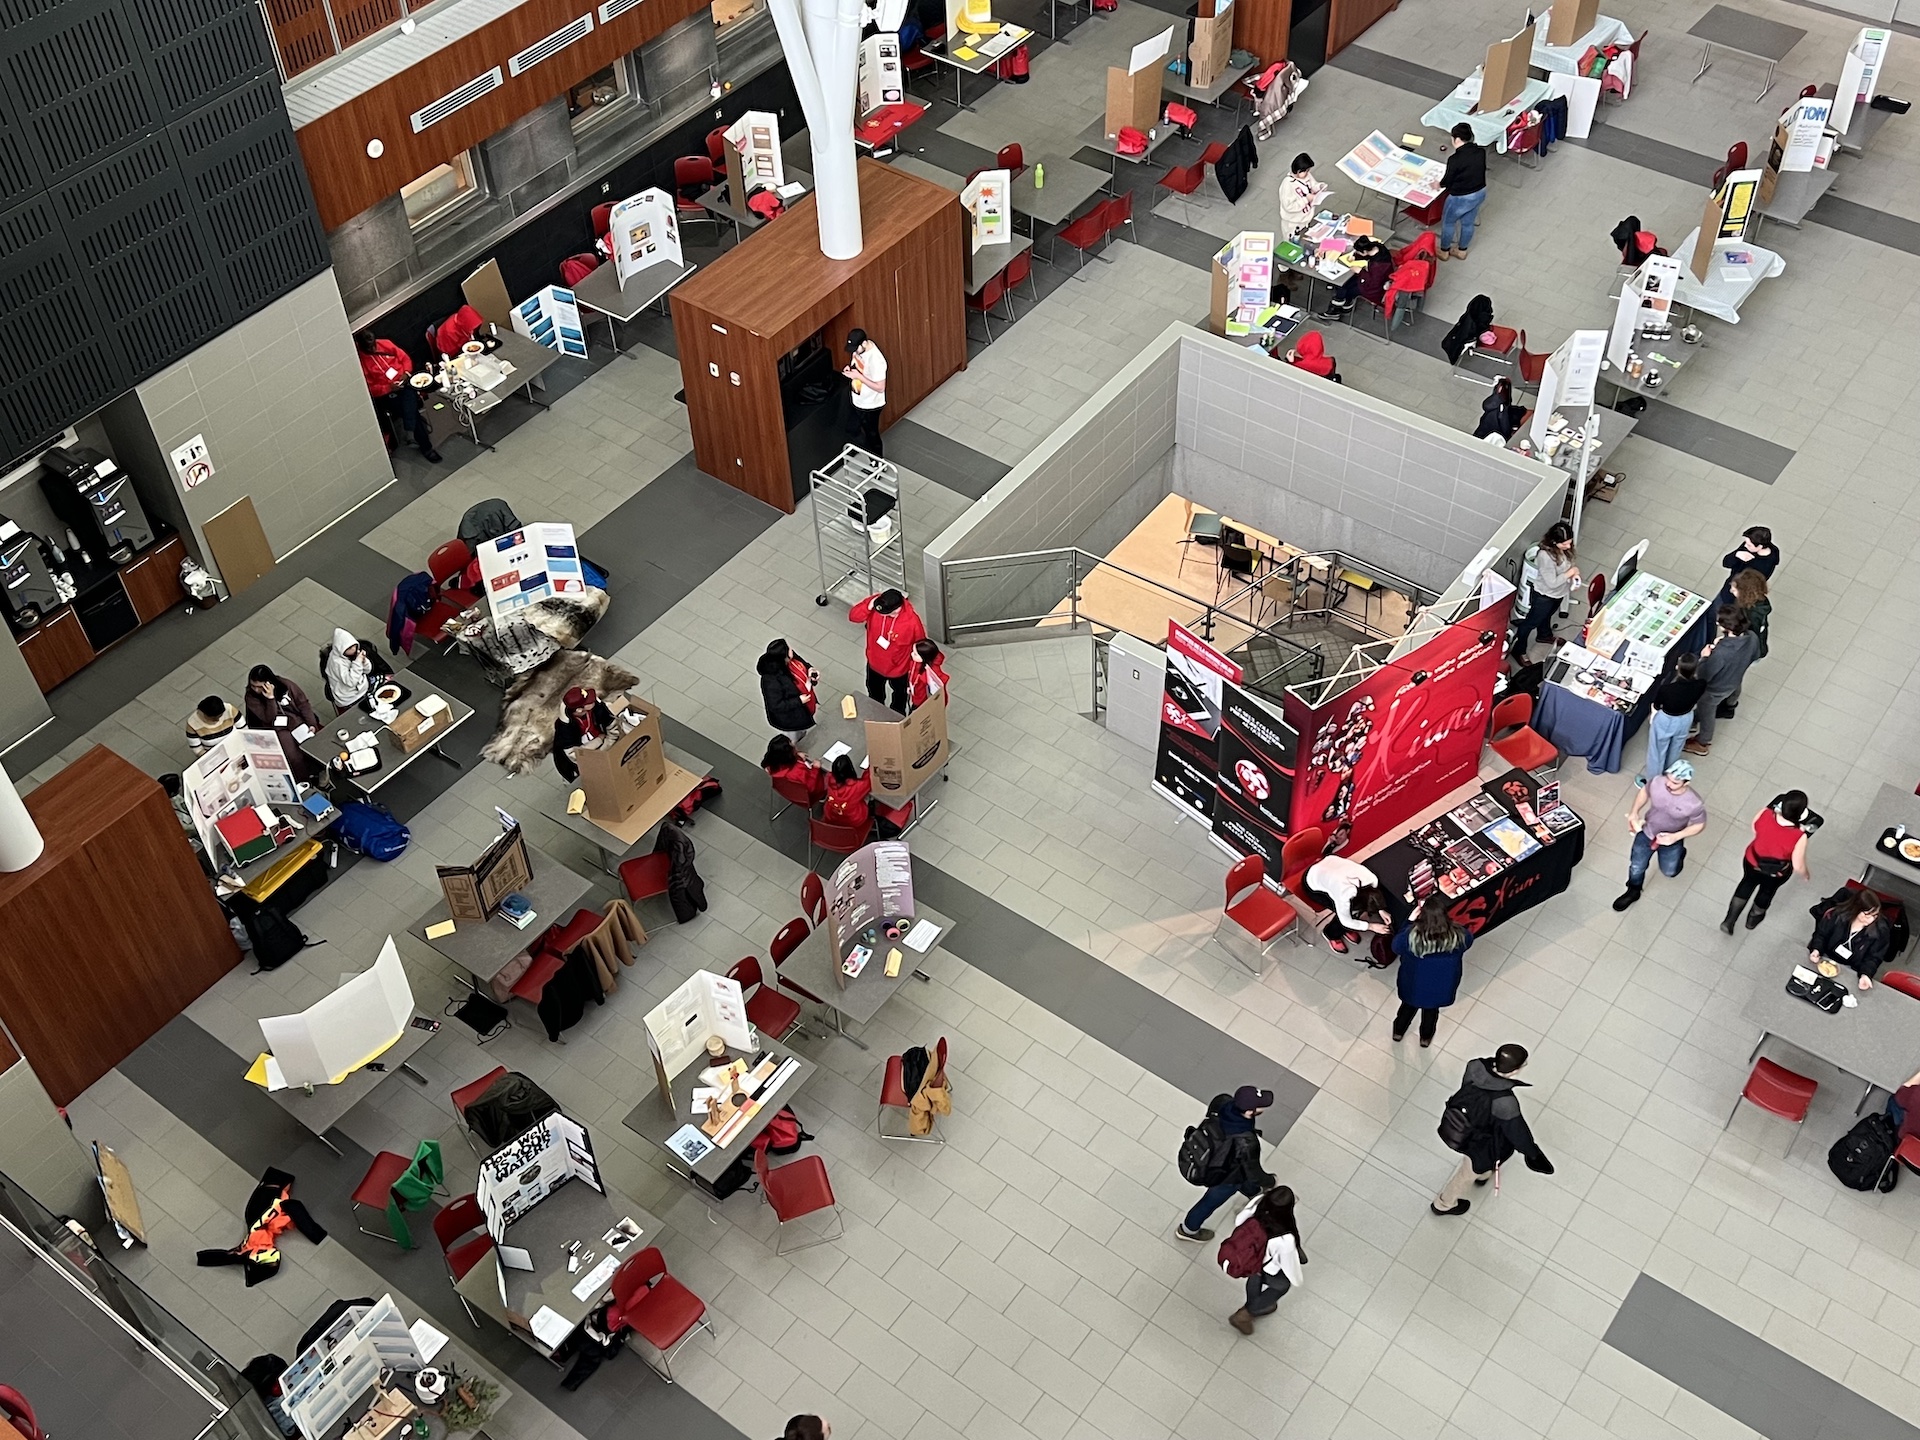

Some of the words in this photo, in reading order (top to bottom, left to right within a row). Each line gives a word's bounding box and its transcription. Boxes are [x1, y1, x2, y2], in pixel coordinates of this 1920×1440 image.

[1355, 697, 1485, 798] Kiuna
[485, 1148, 512, 1171] How
[518, 1120, 547, 1145] Well
[495, 1141, 551, 1183] WATER?
[512, 1129, 551, 1159] YOUR
